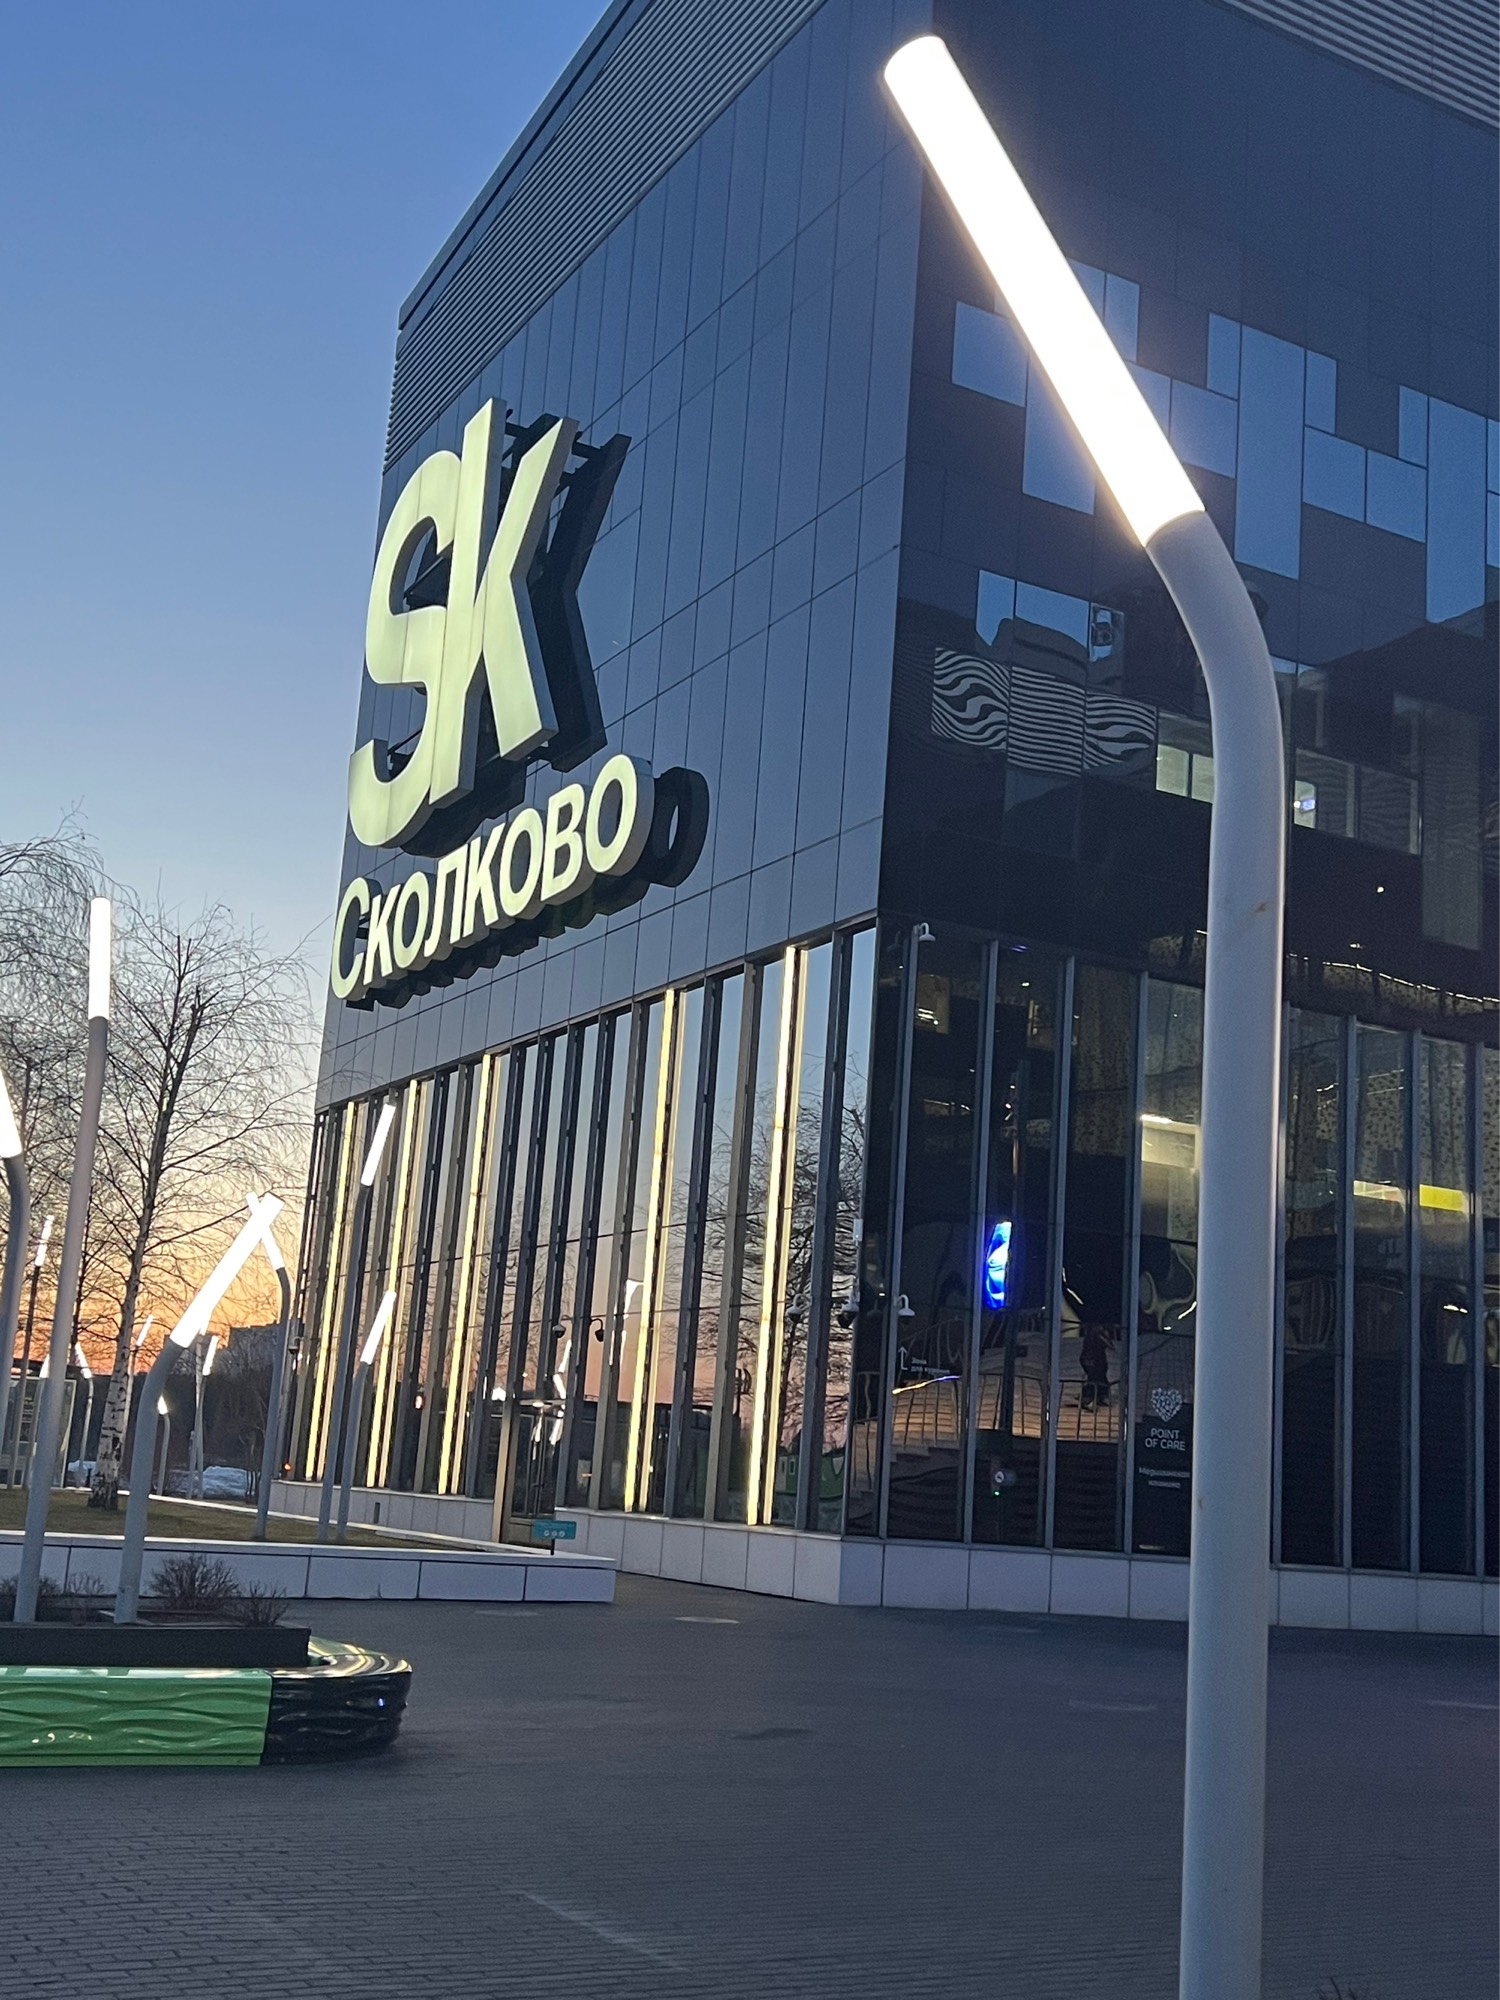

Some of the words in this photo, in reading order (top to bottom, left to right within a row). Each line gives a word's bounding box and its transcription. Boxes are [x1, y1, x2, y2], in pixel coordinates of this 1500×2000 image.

[1150, 1427, 1180, 1439] POINT
[1144, 1437, 1158, 1448] OF
[1160, 1439, 1186, 1451] CARE
